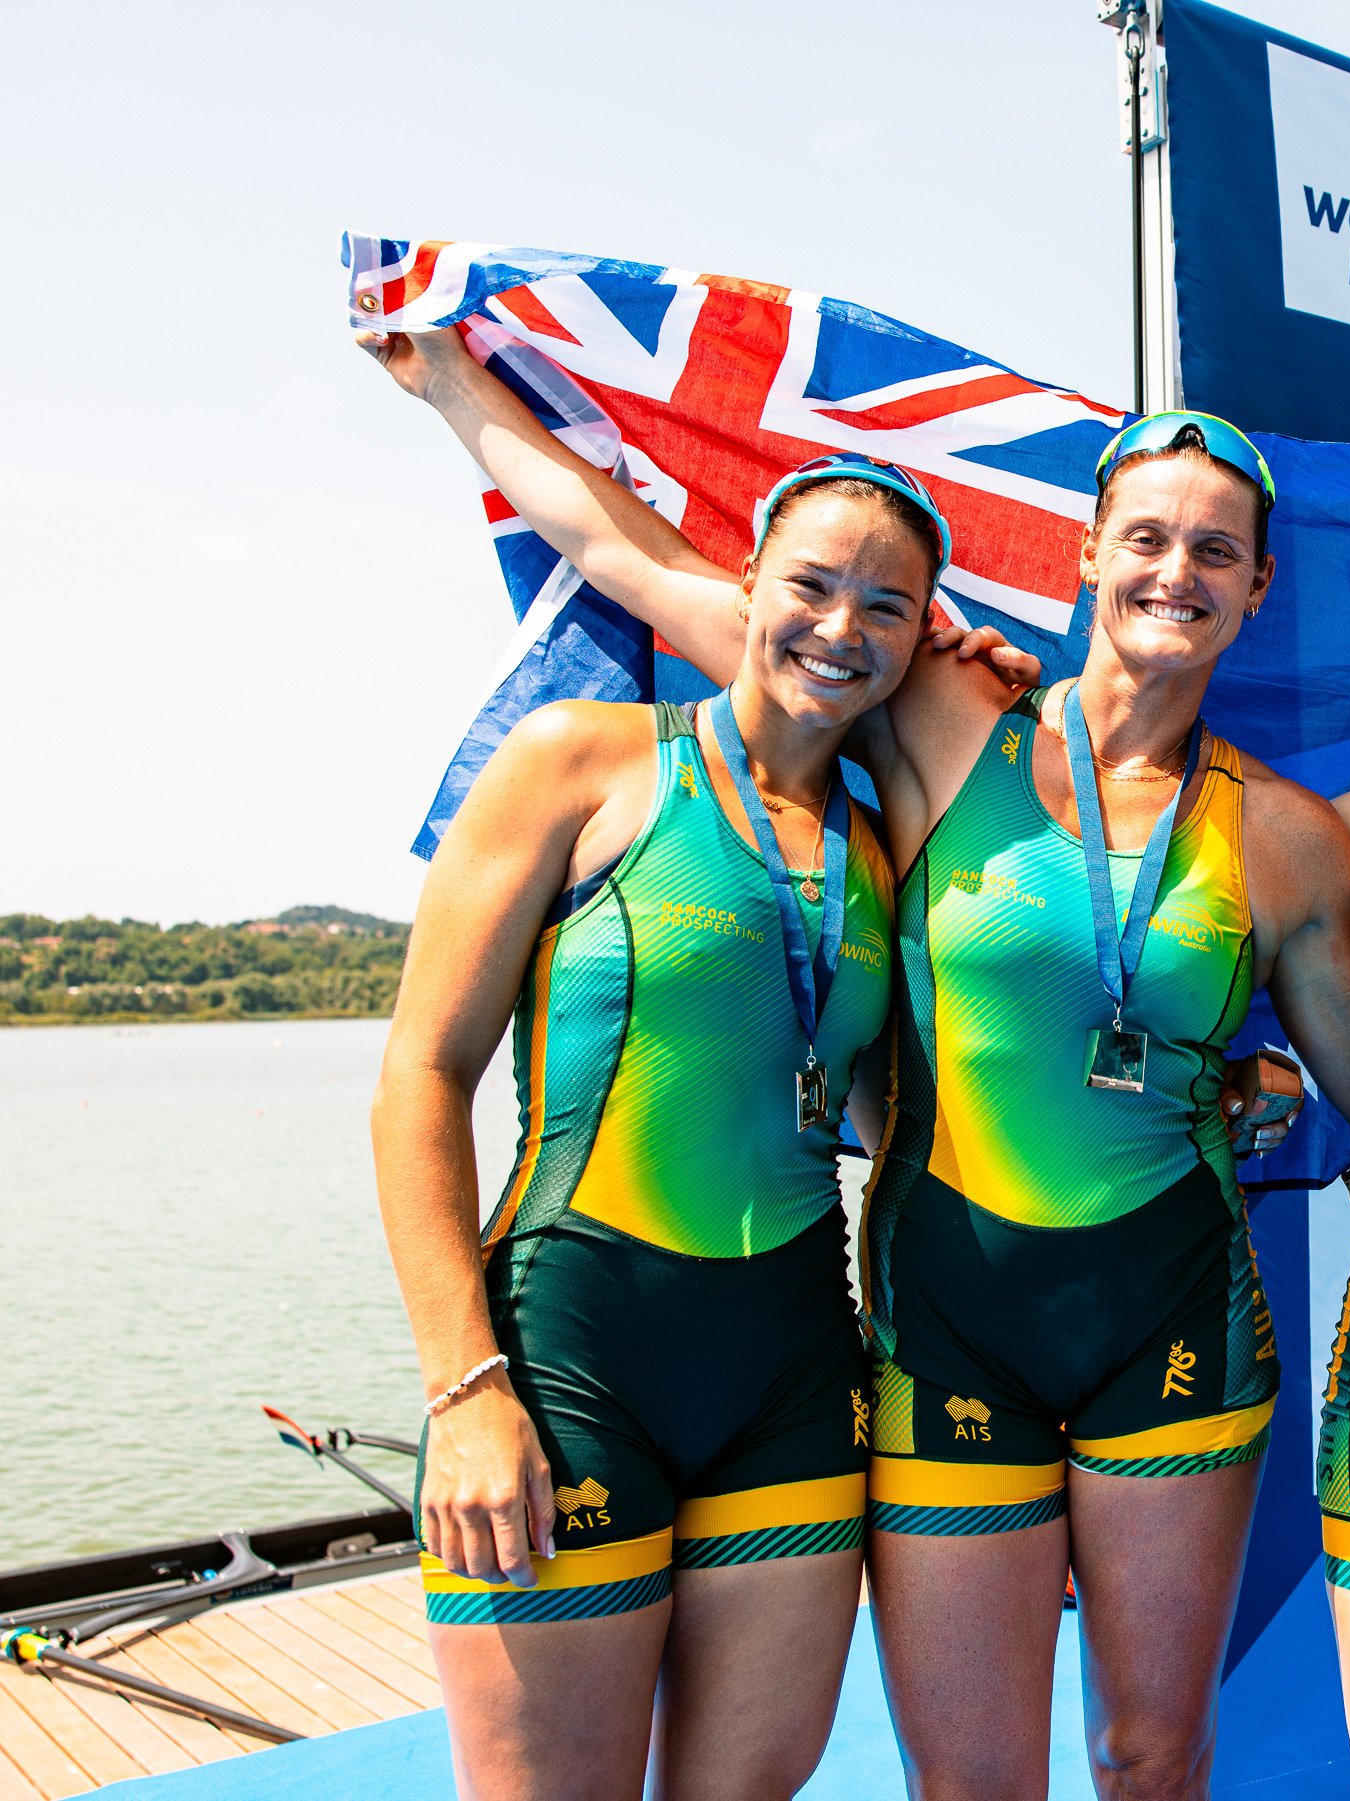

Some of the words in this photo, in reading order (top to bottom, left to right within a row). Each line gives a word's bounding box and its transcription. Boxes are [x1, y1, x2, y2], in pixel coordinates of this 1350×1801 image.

[952, 869, 1018, 889] HANCOCK
[950, 880, 1047, 909] PROSPECTING
[661, 901, 738, 924] HANCOCK
[660, 913, 765, 943] PROSPECTING
[954, 1423, 992, 1442] AIS
[566, 1509, 611, 1532] AIS
